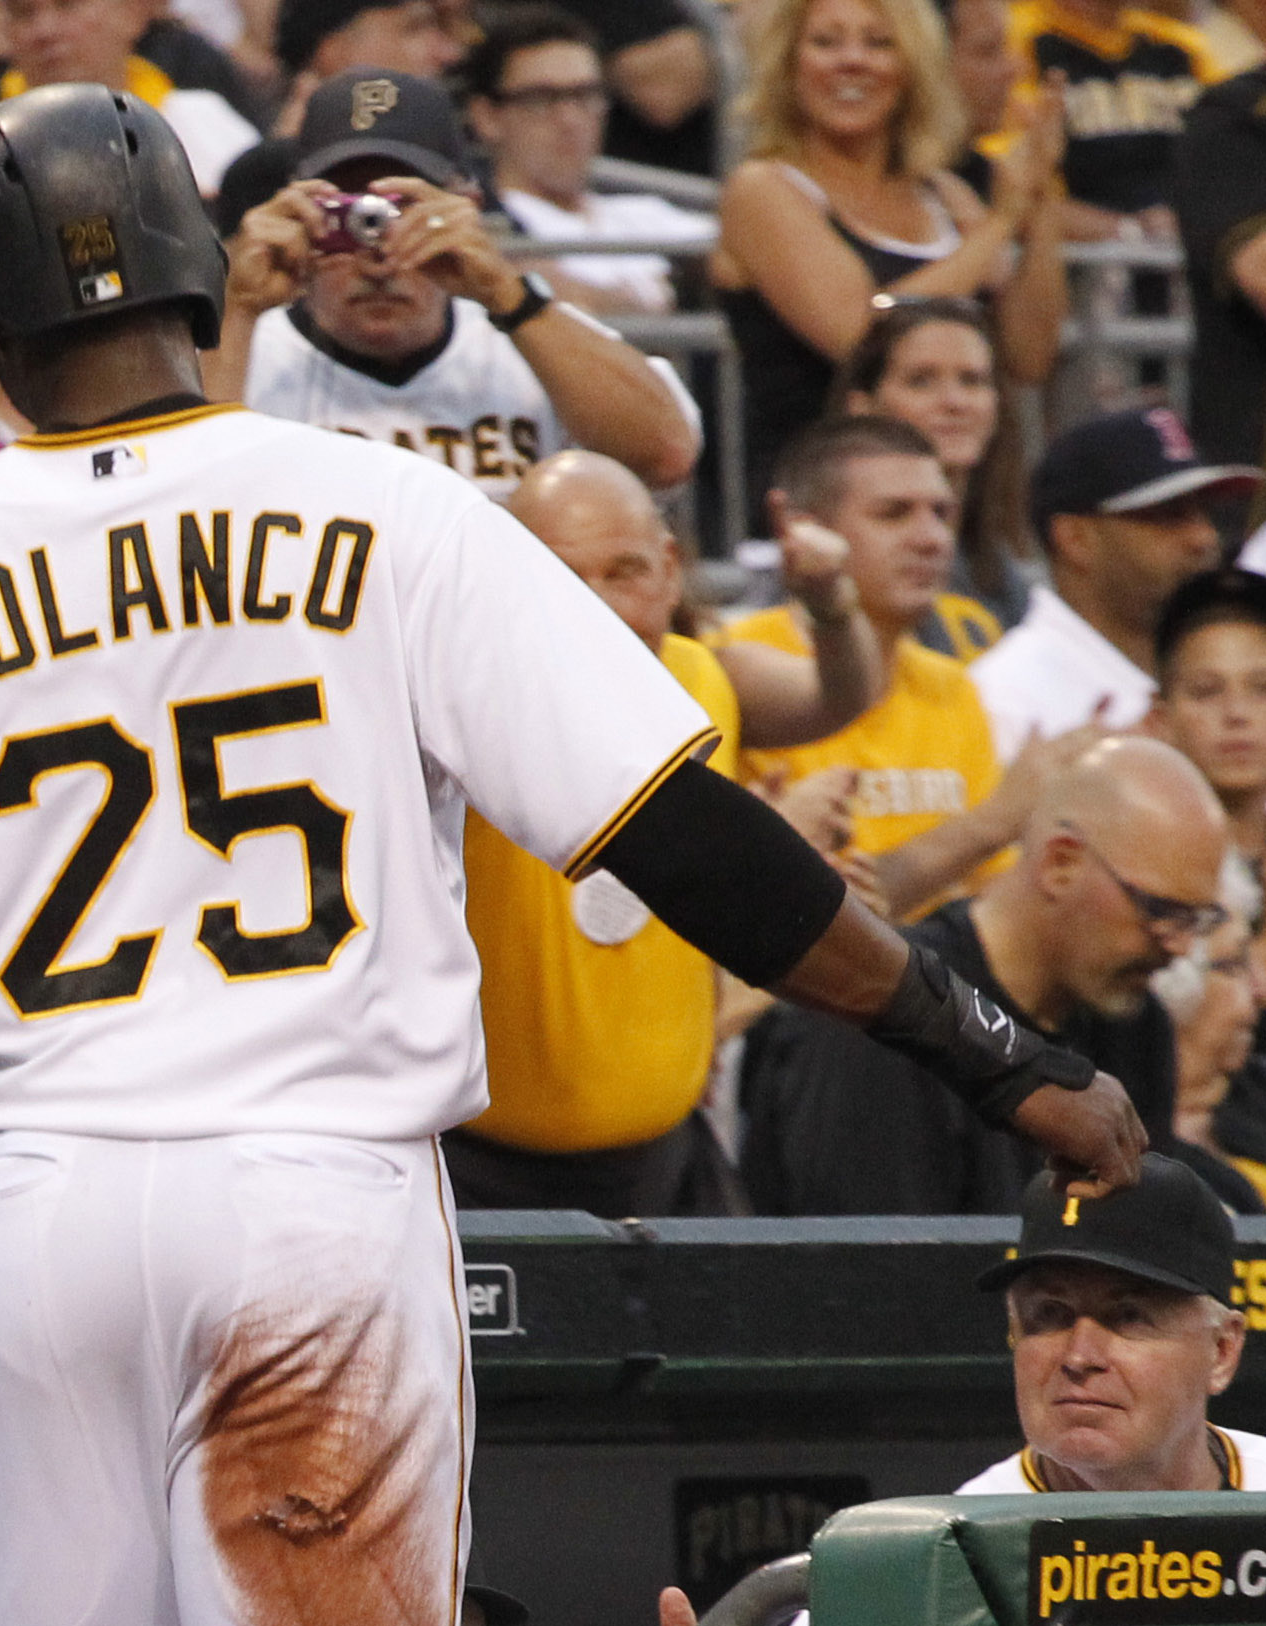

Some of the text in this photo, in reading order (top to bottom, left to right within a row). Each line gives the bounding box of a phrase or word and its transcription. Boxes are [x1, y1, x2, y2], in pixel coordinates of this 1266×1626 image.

[351, 79, 399, 131] P
[63, 217, 116, 264] 25
[467, 1284, 502, 1316] er
[1039, 1540, 1266, 1618] pirates.c
